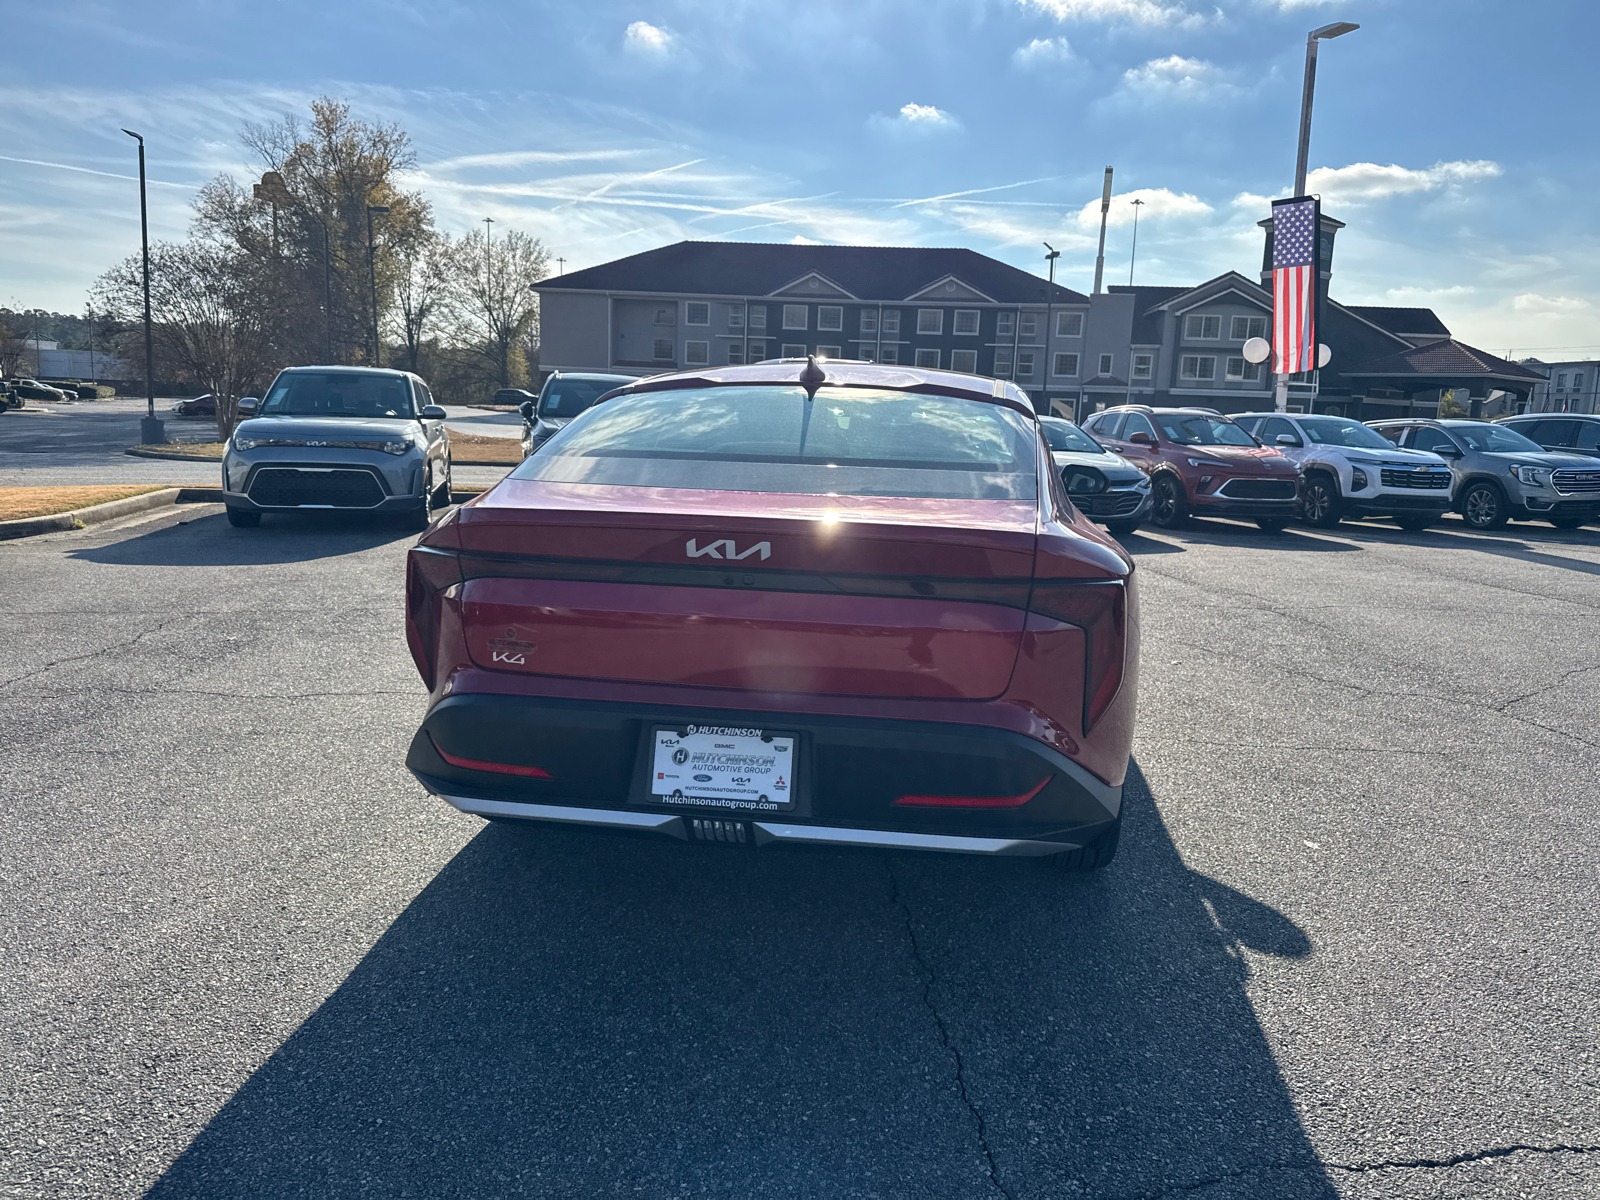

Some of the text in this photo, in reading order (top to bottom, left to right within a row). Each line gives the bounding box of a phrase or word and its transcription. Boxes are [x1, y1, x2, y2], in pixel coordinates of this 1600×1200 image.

[686, 538, 771, 561] KIA
[492, 651, 525, 665] K4
[699, 726, 763, 737] HUTCHINSON
[692, 764, 771, 774] AUTOMOTIVE GROUP
[685, 786, 759, 794] HUTCHINSONAUTOGROUP.COM
[662, 795, 778, 810] Hutchinsonautogroup.com
